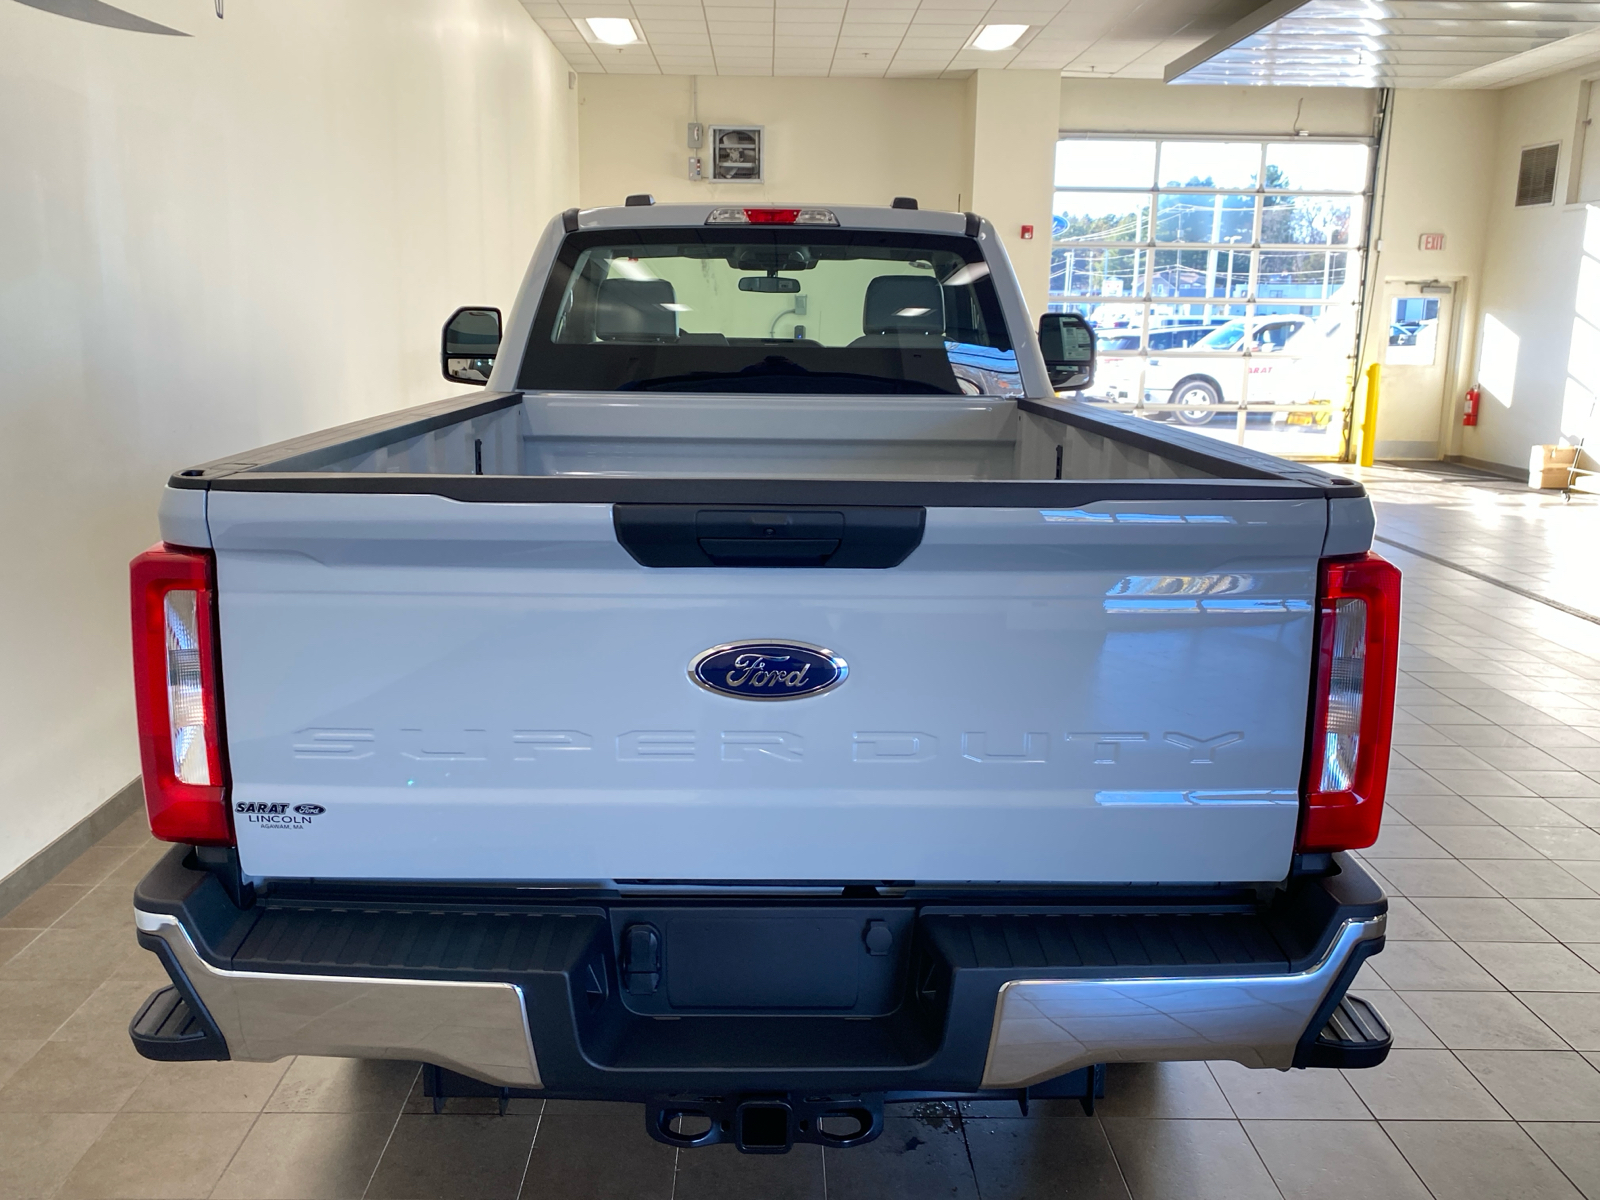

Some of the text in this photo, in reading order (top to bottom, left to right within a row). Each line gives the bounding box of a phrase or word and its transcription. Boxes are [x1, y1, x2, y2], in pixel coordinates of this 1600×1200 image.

[1424, 234, 1444, 250] EXIT
[726, 653, 811, 687] Ford
[293, 727, 1244, 764] SUPER DUTY
[235, 802, 290, 815] SARAT
[248, 815, 312, 824] LINCOLN
